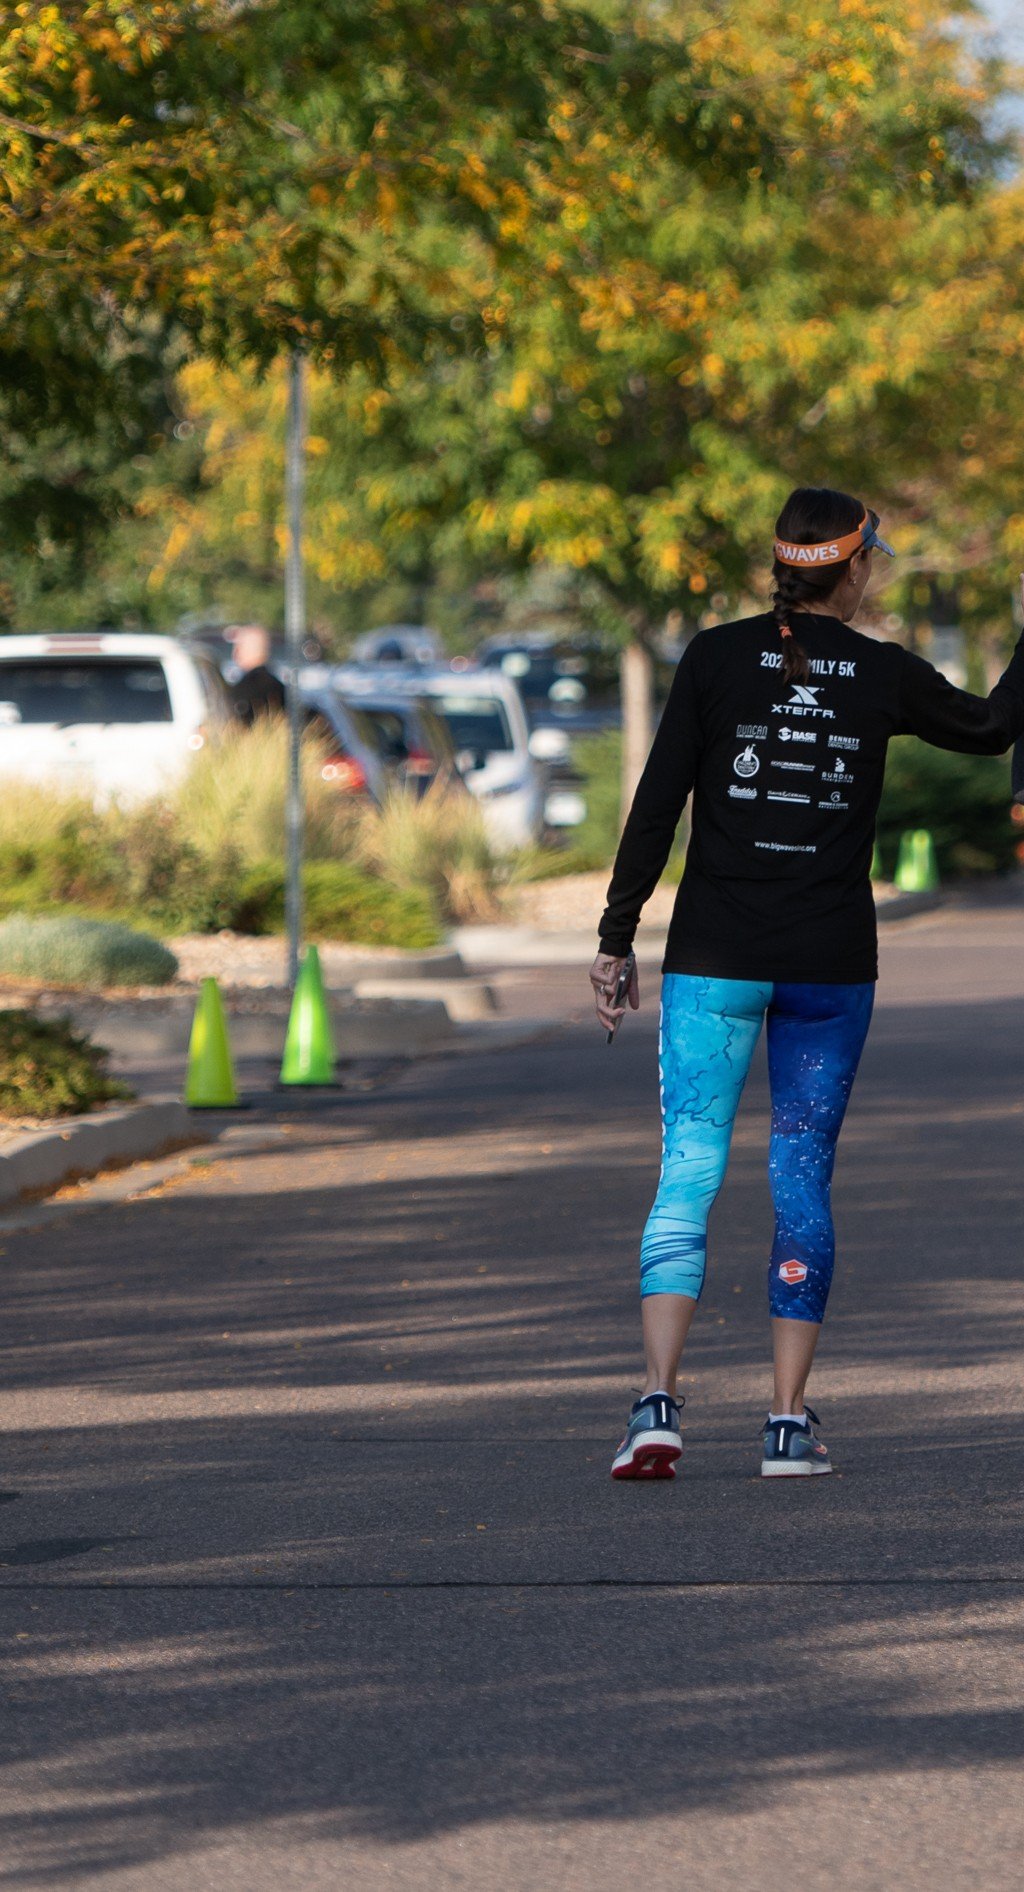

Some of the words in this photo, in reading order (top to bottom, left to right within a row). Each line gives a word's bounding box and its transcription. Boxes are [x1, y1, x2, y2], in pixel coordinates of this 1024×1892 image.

[760, 651, 789, 670] 202
[807, 658, 836, 675] MILY
[838, 661, 856, 677] 5K
[792, 731, 817, 739] BASE
[828, 735, 860, 743] BENNETT
[821, 771, 854, 780] BURDEN
